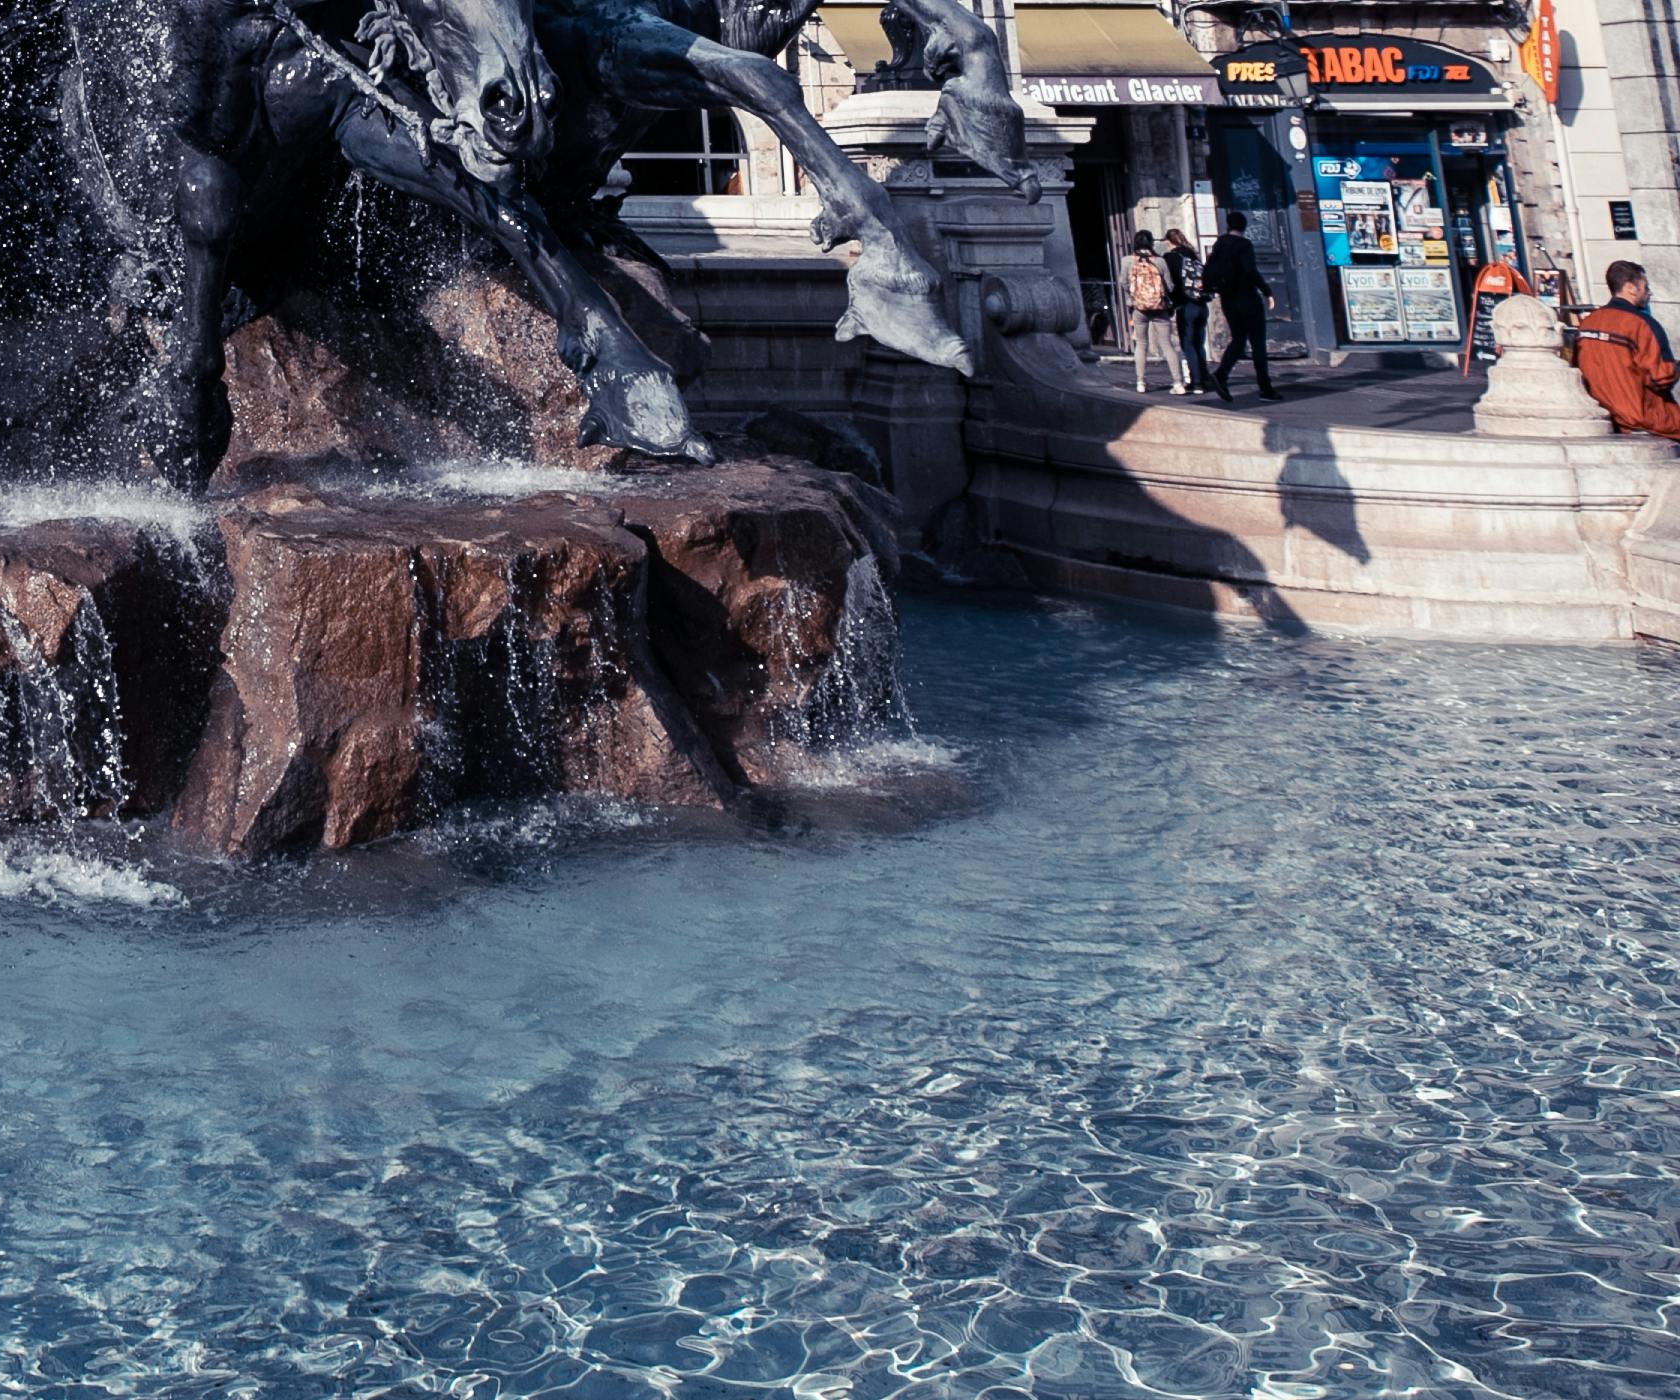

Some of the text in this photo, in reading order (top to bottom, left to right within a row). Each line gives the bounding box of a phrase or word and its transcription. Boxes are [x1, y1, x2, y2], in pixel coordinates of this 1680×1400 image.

[1541, 16, 1553, 82] TABAC
[1227, 62, 1276, 82] PRES
[1300, 46, 1406, 84] TABAC
[1128, 79, 1203, 102] Glacier
[1320, 163, 1341, 174] FDJ
